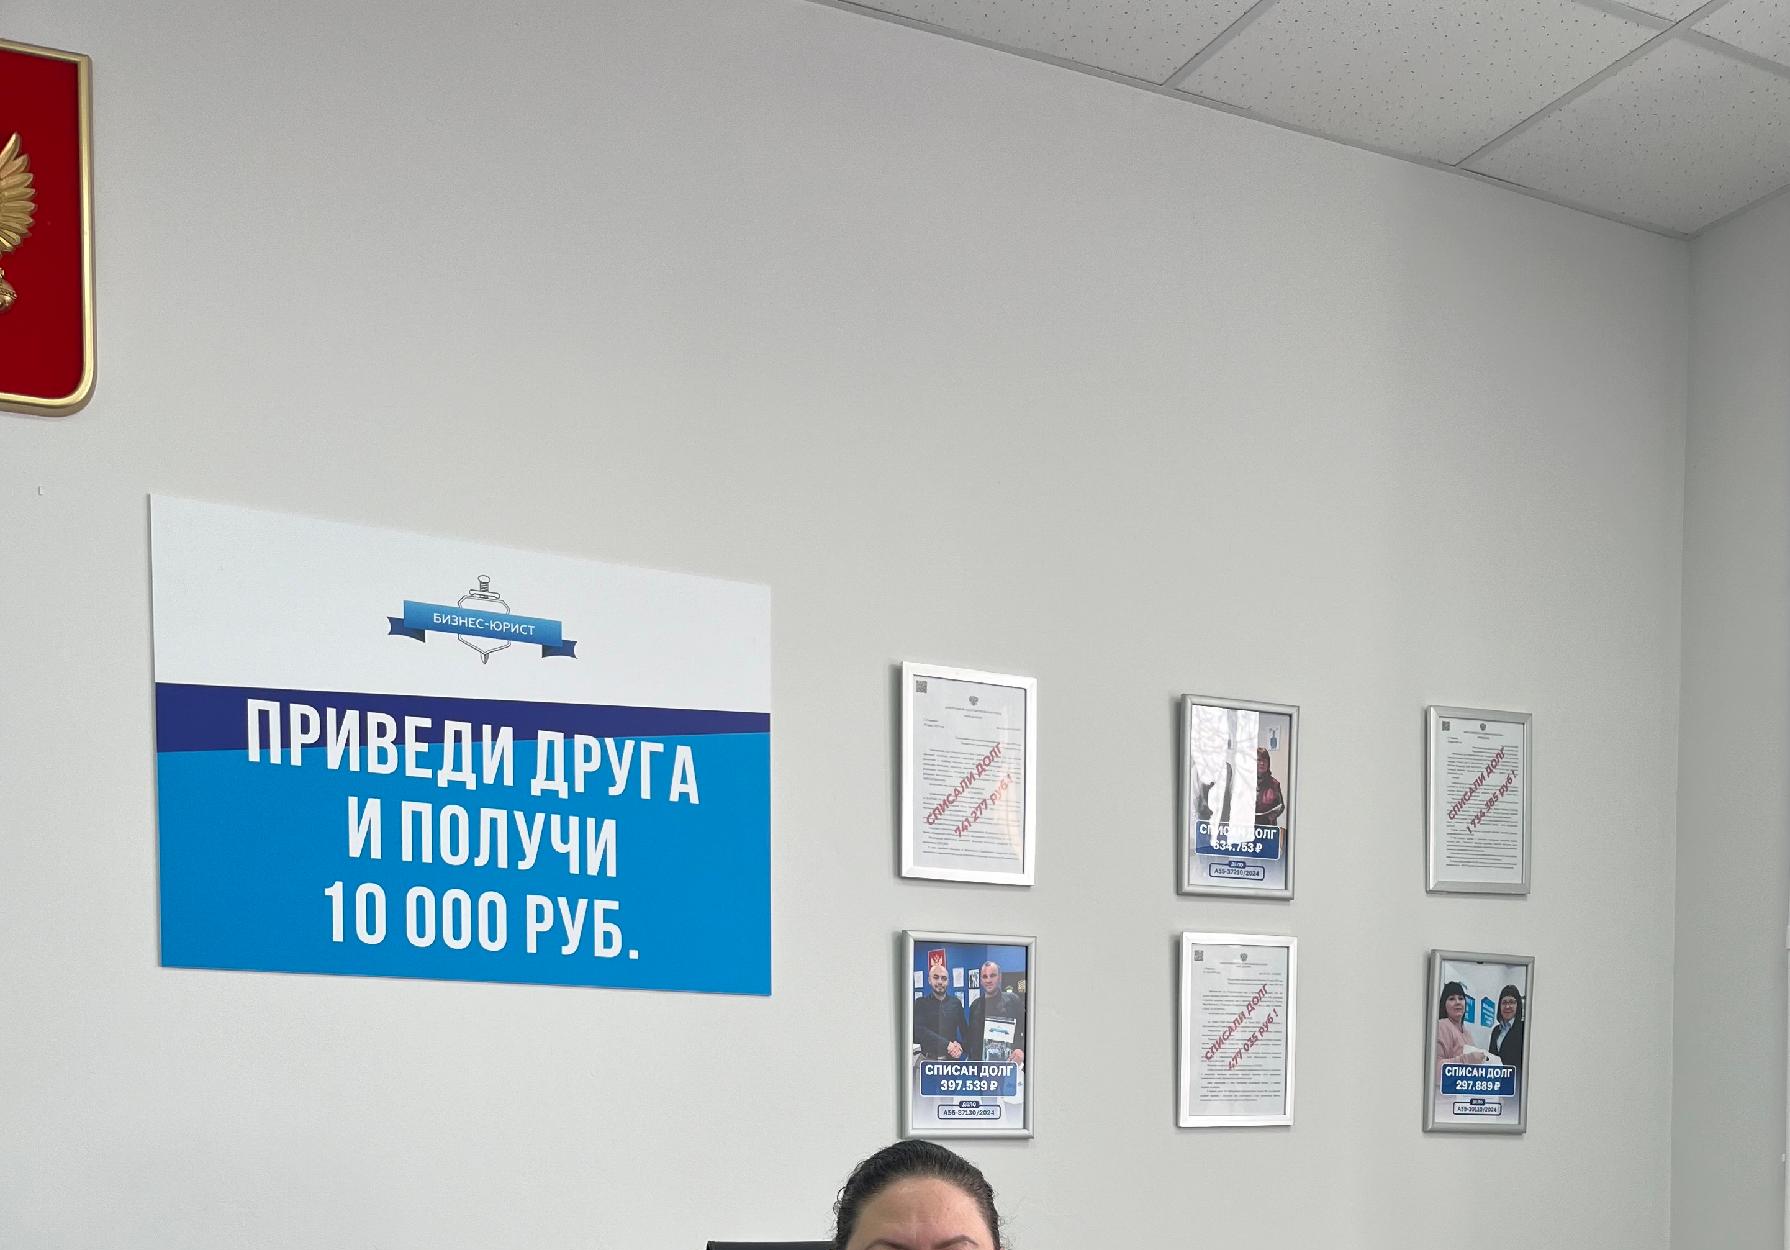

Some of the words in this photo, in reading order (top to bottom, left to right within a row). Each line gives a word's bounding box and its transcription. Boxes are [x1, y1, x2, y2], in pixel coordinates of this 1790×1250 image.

[432, 611, 536, 637] БИЗНЕС-ЮРИСТ
[246, 698, 515, 791] ПРИВЕДИ
[530, 730, 700, 805] ДРУГА
[926, 770, 976, 826] СПИСАЛИ
[975, 741, 1003, 778] ДОЛГ
[1448, 771, 1486, 820] СПИСАЛИ
[1485, 745, 1505, 778] ДОЛГ
[347, 796, 382, 860] И
[401, 801, 618, 878] ПОЛУЧИ
[324, 881, 386, 945] 10
[405, 886, 508, 952] 000
[526, 894, 640, 961] РУБ.
[1205, 1010, 1247, 1061] СПИСАЛИ
[1246, 983, 1268, 1016] ДОЛГ
[925, 1064, 978, 1076] СПИСАН
[980, 1065, 1014, 1078] ДОЛГ
[940, 1079, 988, 1091] 397.539
[1444, 1066, 1486, 1077] СПИСАН
[1486, 1067, 1513, 1079] ДОЛГ
[1455, 1080, 1493, 1091] 297.889
